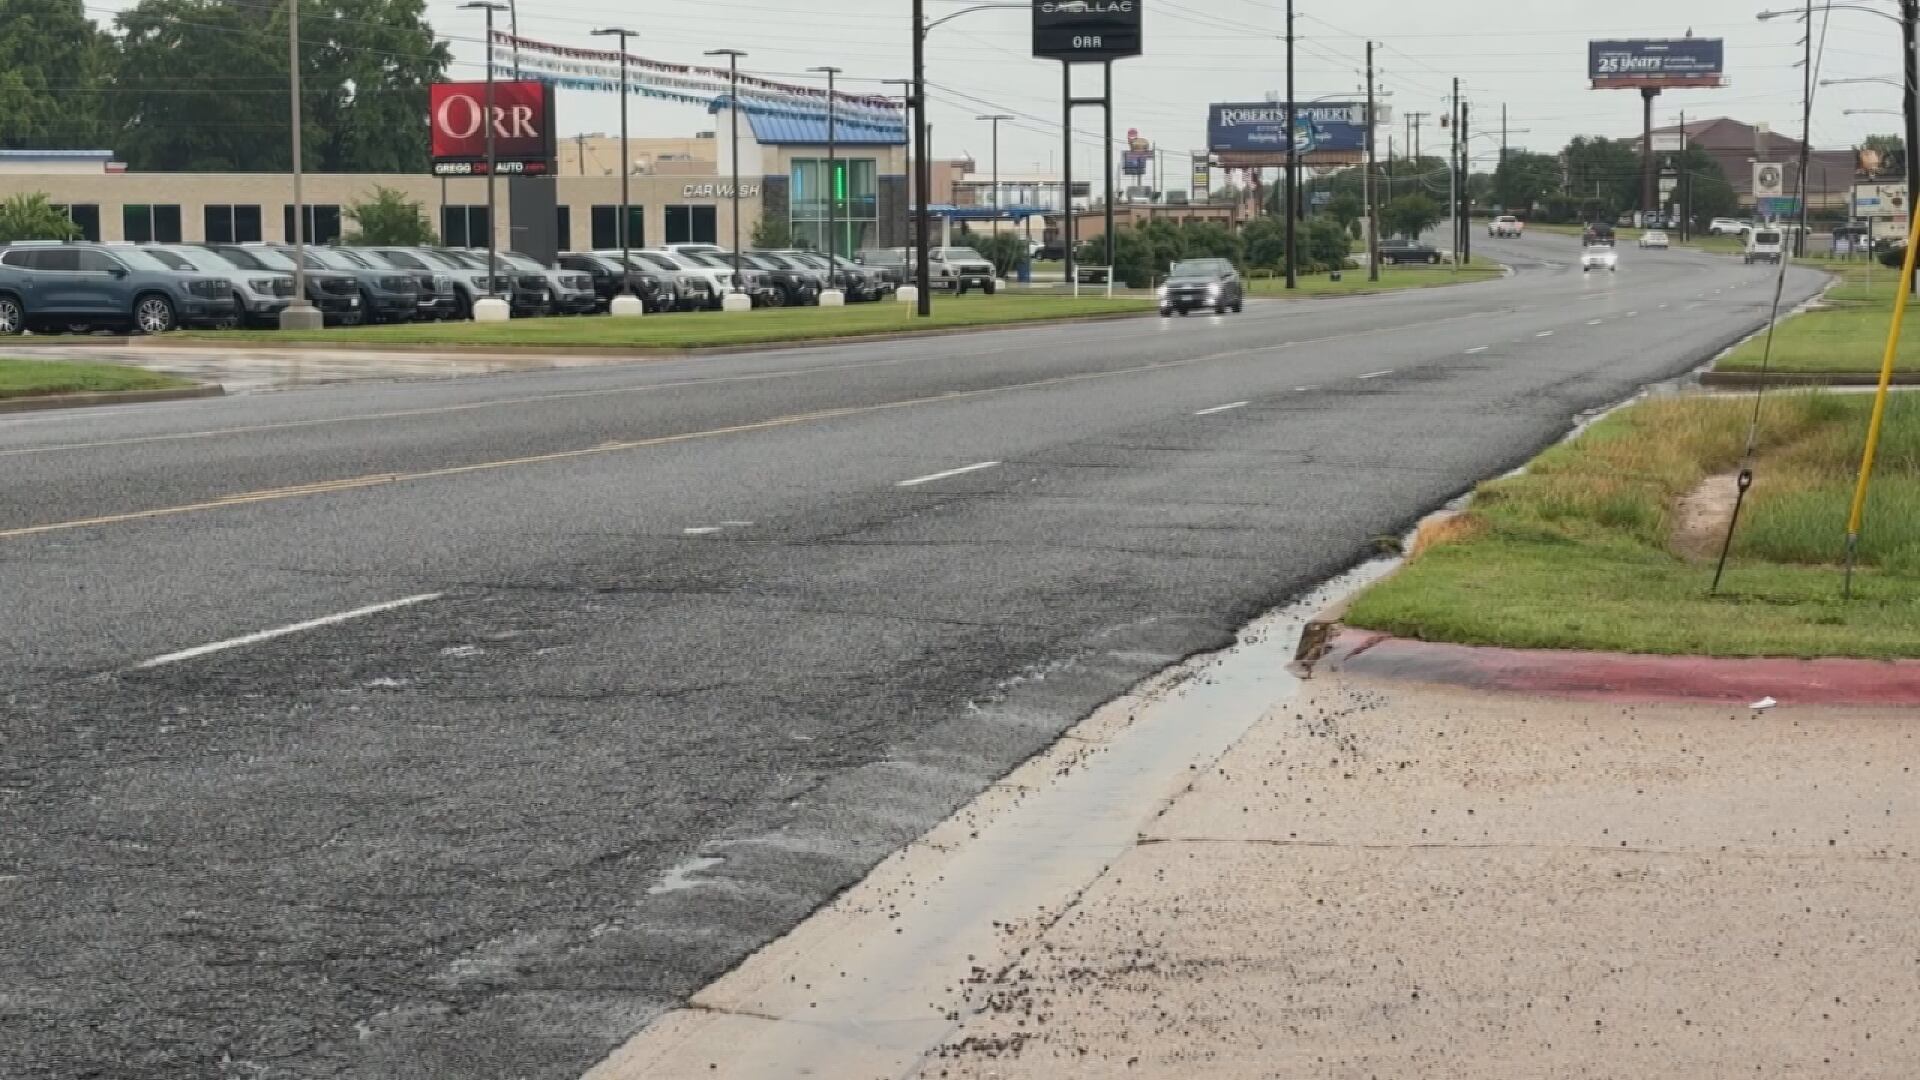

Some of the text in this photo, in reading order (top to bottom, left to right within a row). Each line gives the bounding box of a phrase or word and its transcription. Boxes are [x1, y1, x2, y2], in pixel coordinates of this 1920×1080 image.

[1073, 35, 1102, 48] ORR
[1598, 58, 1618, 73] 25
[437, 94, 539, 139] ORR
[1220, 108, 1283, 126] ROBERTS
[683, 184, 713, 198] CAR
